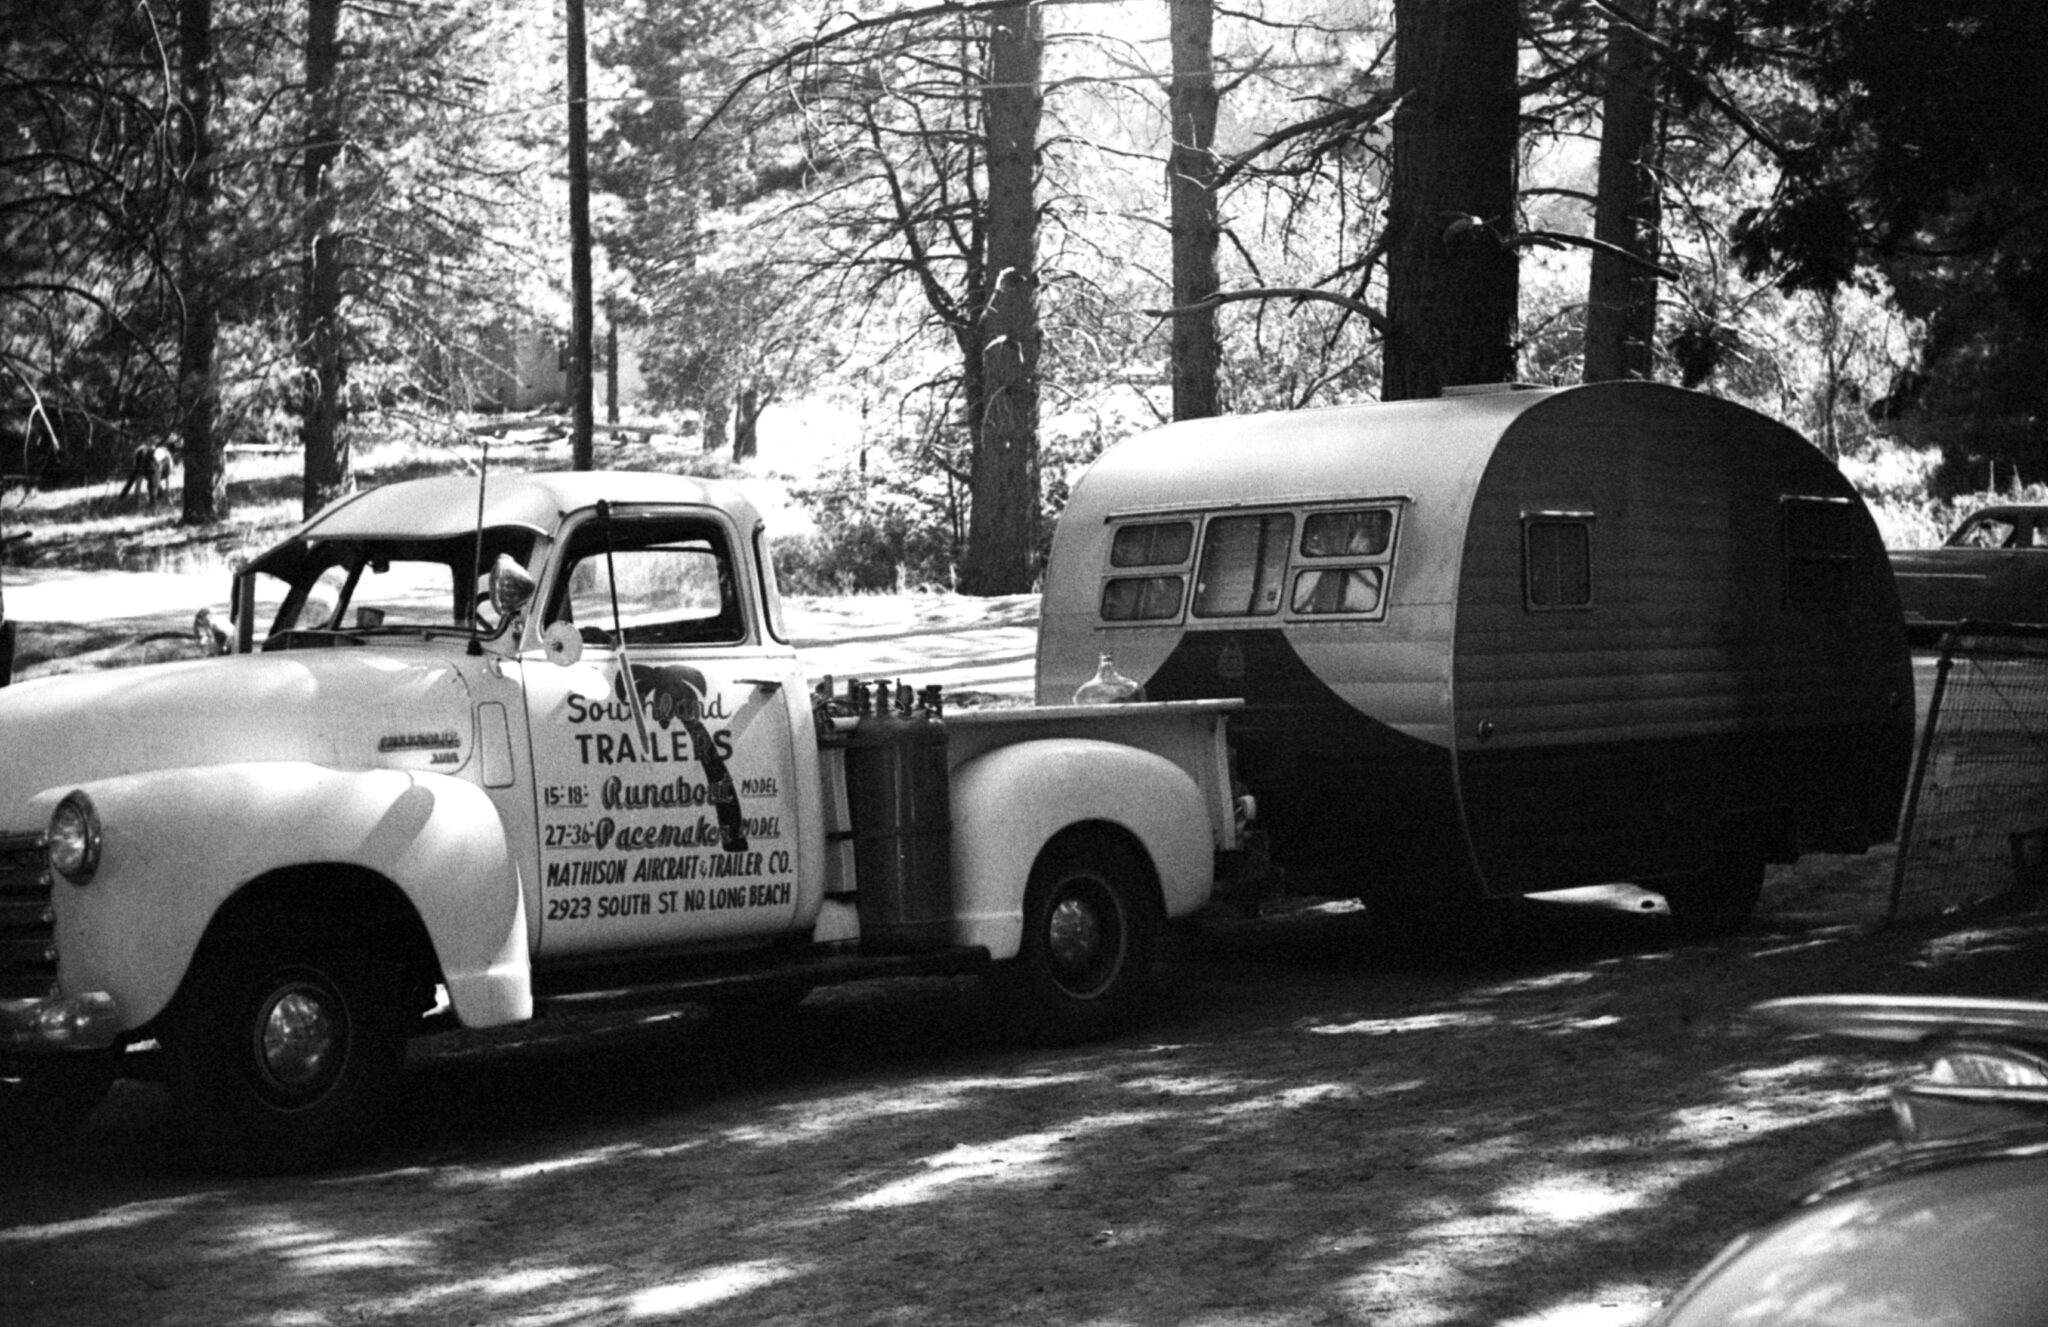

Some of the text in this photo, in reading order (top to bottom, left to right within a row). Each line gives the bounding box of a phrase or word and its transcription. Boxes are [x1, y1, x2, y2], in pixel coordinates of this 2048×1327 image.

[567, 692, 731, 723] Souhland
[575, 729, 733, 764] TRALERS
[602, 776, 734, 810] Runabout
[741, 777, 779, 794] MODEL
[595, 816, 732, 851] Pacemaker
[740, 816, 781, 837] MODEL
[547, 850, 793, 887] MATHISON AIRCRAFT & TRAILER CO.
[548, 897, 591, 920] 2923
[598, 894, 650, 918] SOUTH
[709, 886, 747, 910] LONG
[749, 883, 791, 907] BEACH
